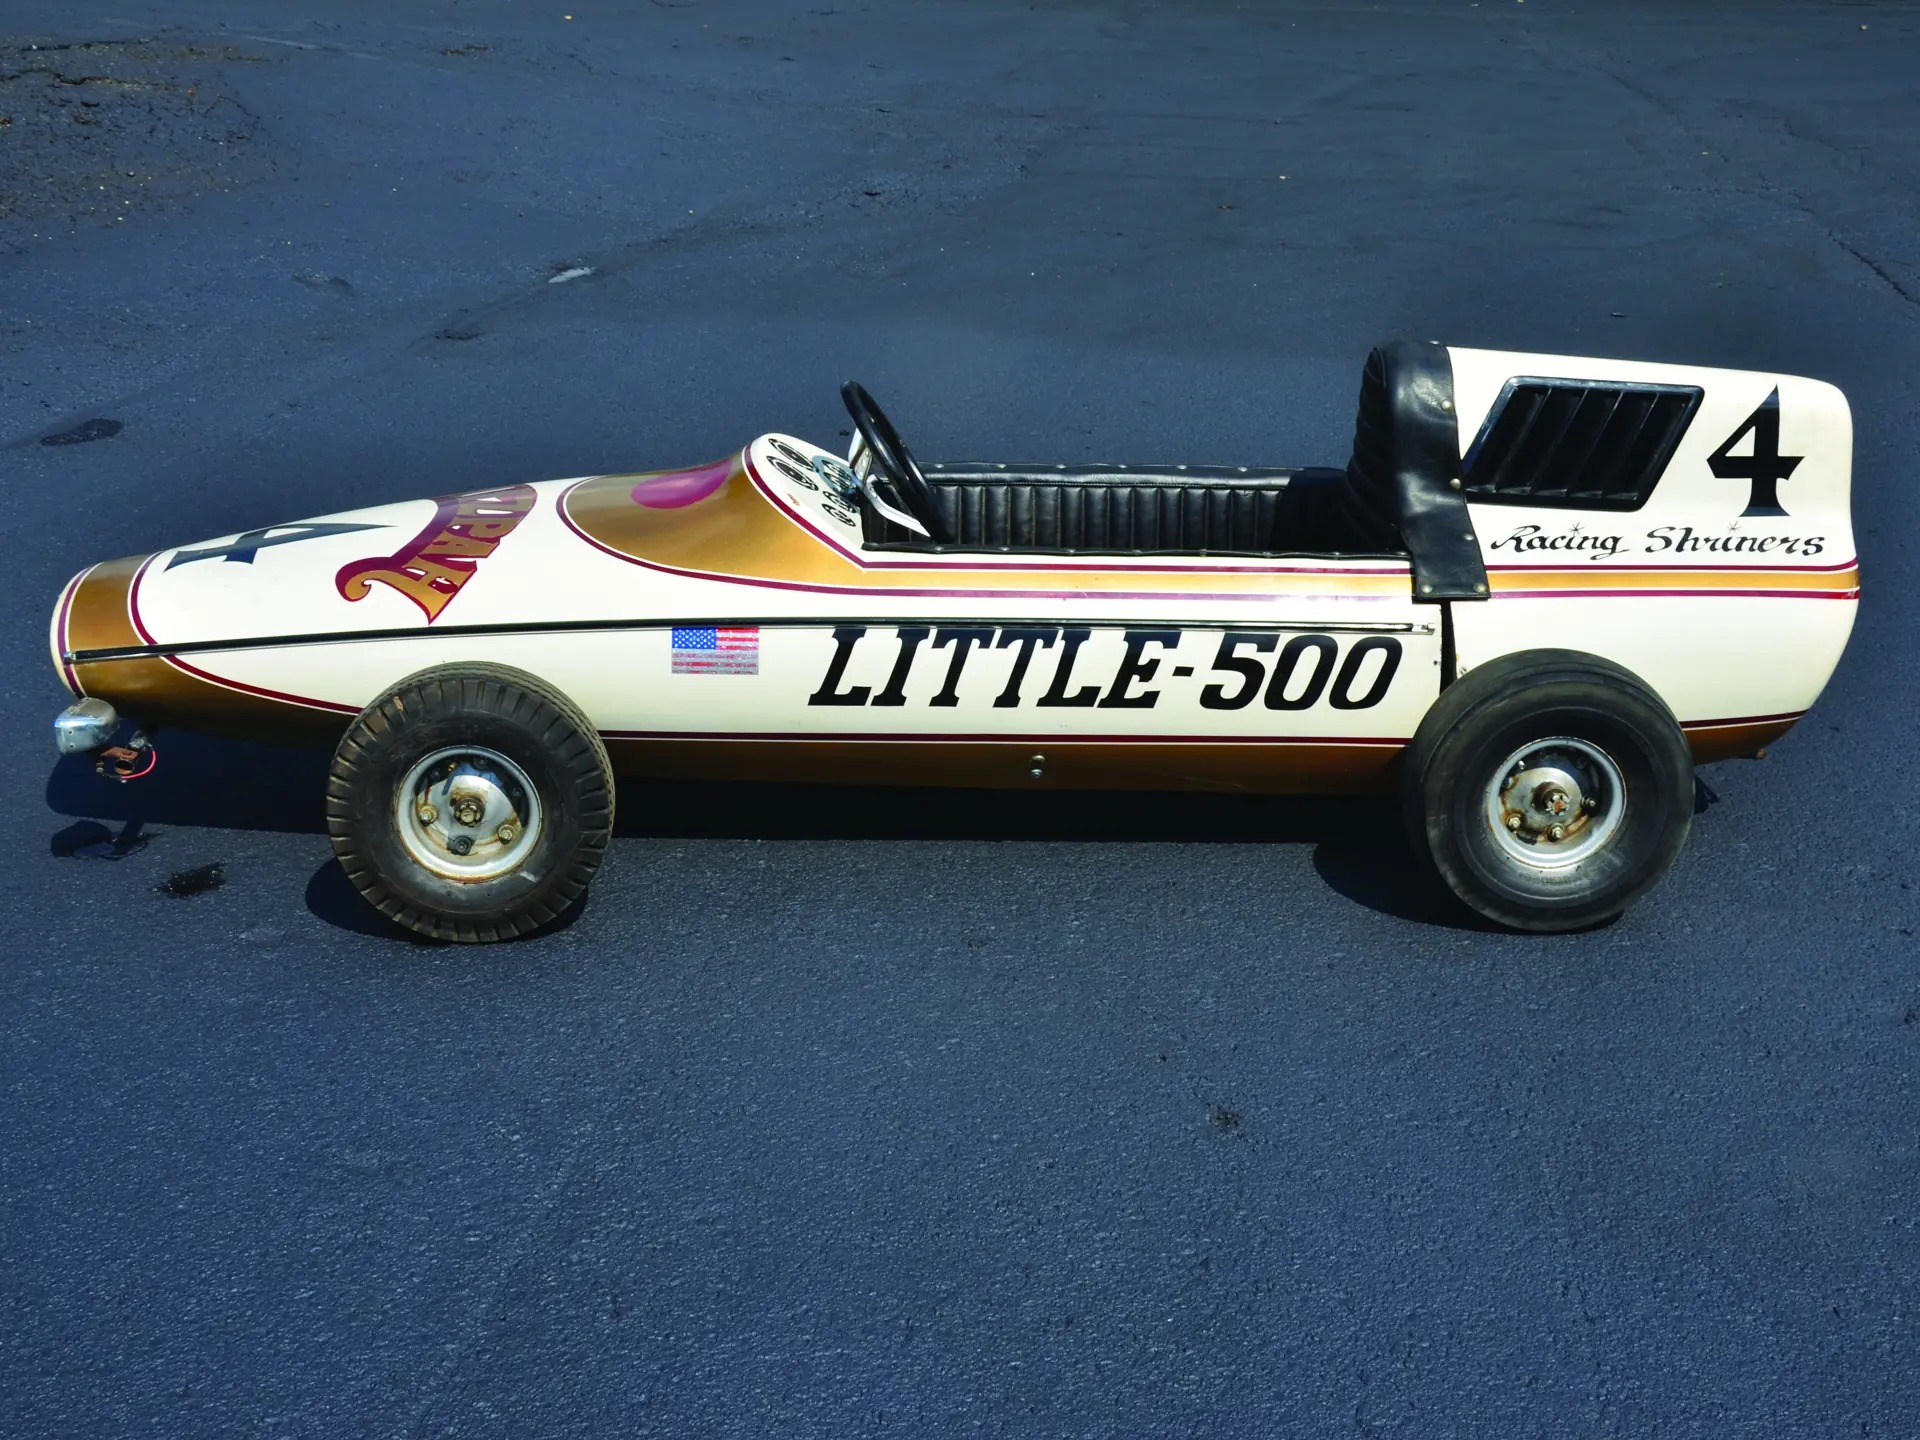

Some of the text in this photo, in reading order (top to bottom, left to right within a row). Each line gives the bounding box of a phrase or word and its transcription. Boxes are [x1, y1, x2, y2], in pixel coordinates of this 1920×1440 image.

[1706, 384, 1805, 517] 4
[163, 522, 400, 574] 4
[1490, 520, 1826, 560] Racing Shriners
[808, 627, 1403, 711] LITTLE-500
